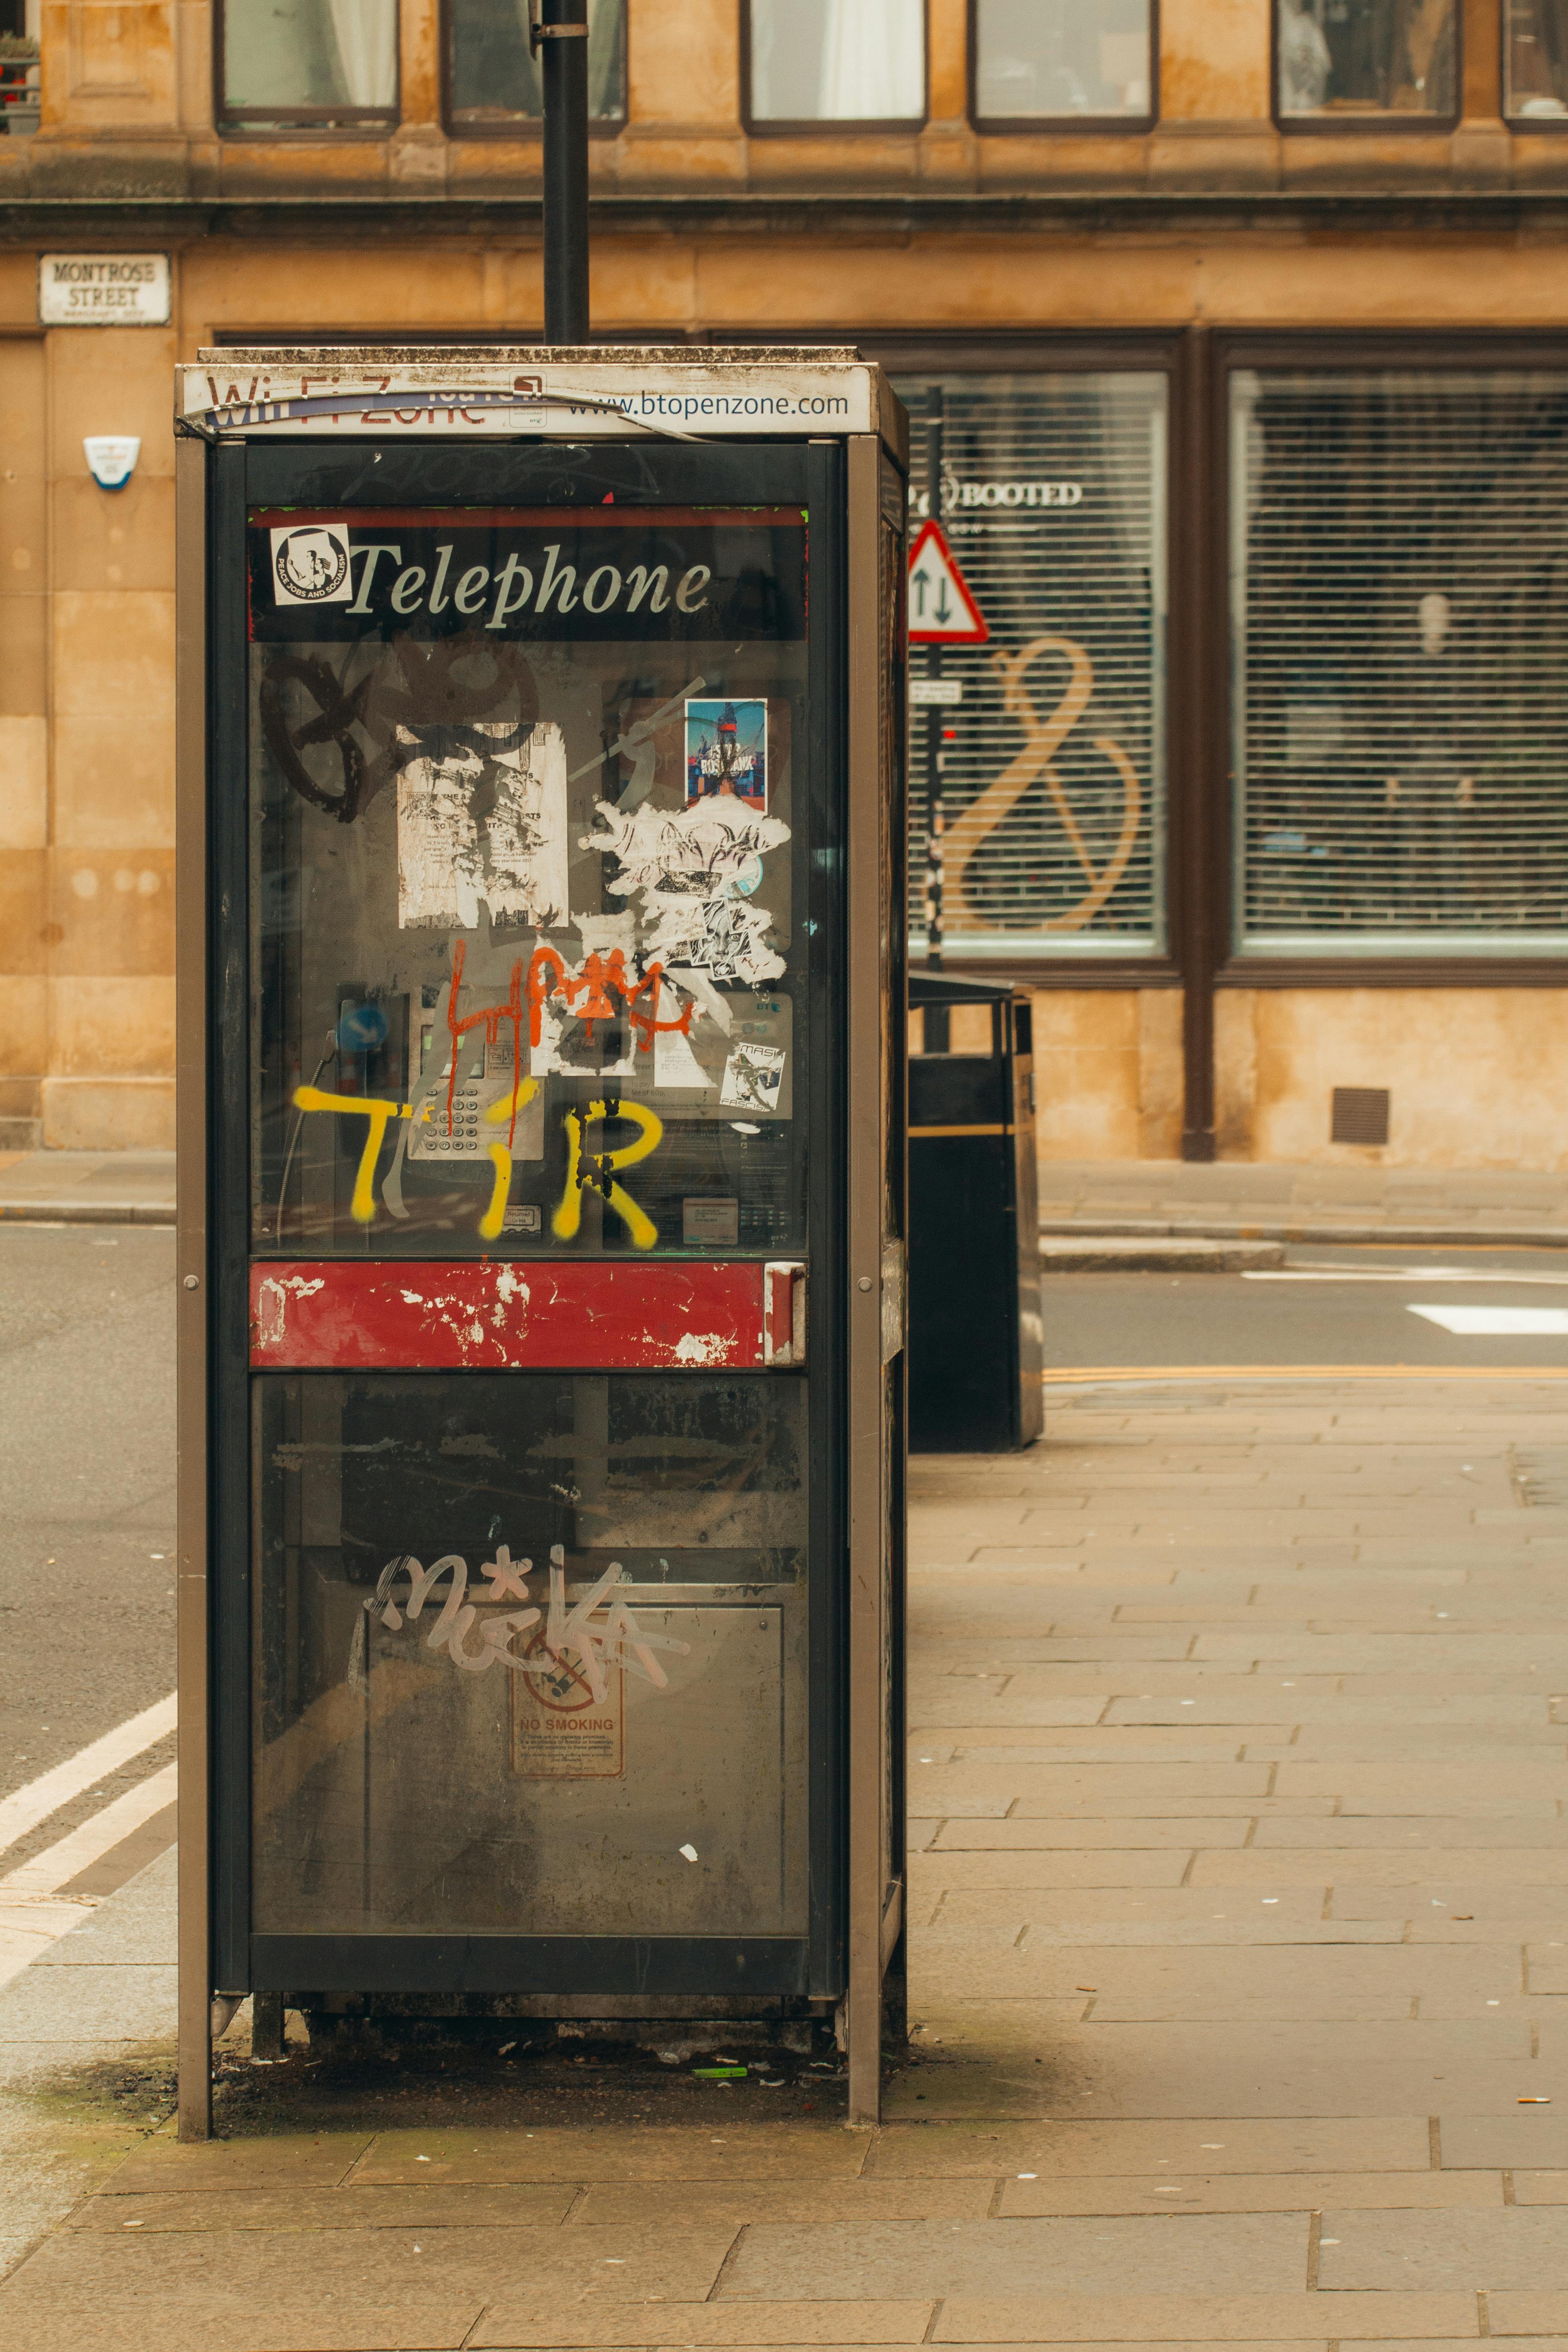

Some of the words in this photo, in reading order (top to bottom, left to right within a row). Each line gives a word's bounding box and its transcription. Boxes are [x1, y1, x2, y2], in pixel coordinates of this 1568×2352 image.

[54, 262, 156, 282] MONTROSE
[69, 286, 139, 306] STREET
[961, 482, 1083, 506] BOOTED
[278, 558, 288, 584] PEACE
[287, 583, 307, 597] JOBS
[308, 590, 325, 598] AND
[326, 554, 345, 593] SOCIALISM
[345, 544, 711, 629] Telephone
[721, 1098, 774, 1112] FASCIS
[520, 1719, 541, 1730] NO
[545, 1719, 614, 1730] SMOKING
